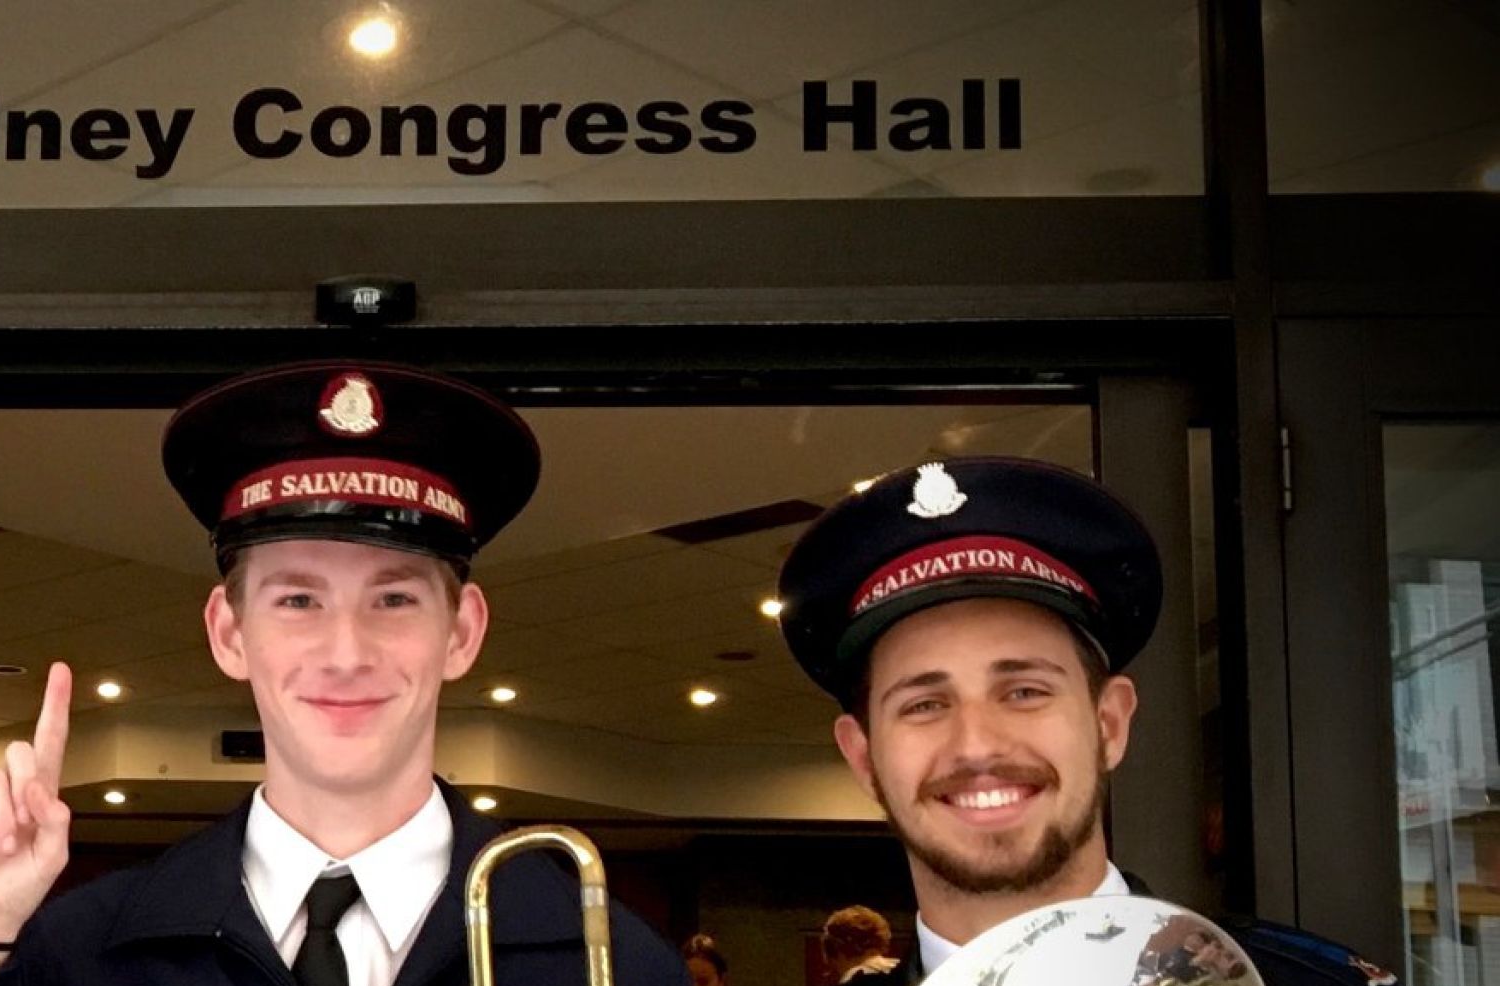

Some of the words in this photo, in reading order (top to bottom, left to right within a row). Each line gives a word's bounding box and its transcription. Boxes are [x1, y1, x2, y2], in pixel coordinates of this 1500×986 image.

[233, 87, 758, 176] Congress
[802, 77, 1023, 153] Hall
[239, 480, 273, 508] THE
[280, 472, 419, 501] SALVATION
[872, 549, 1016, 601] SALVATION
